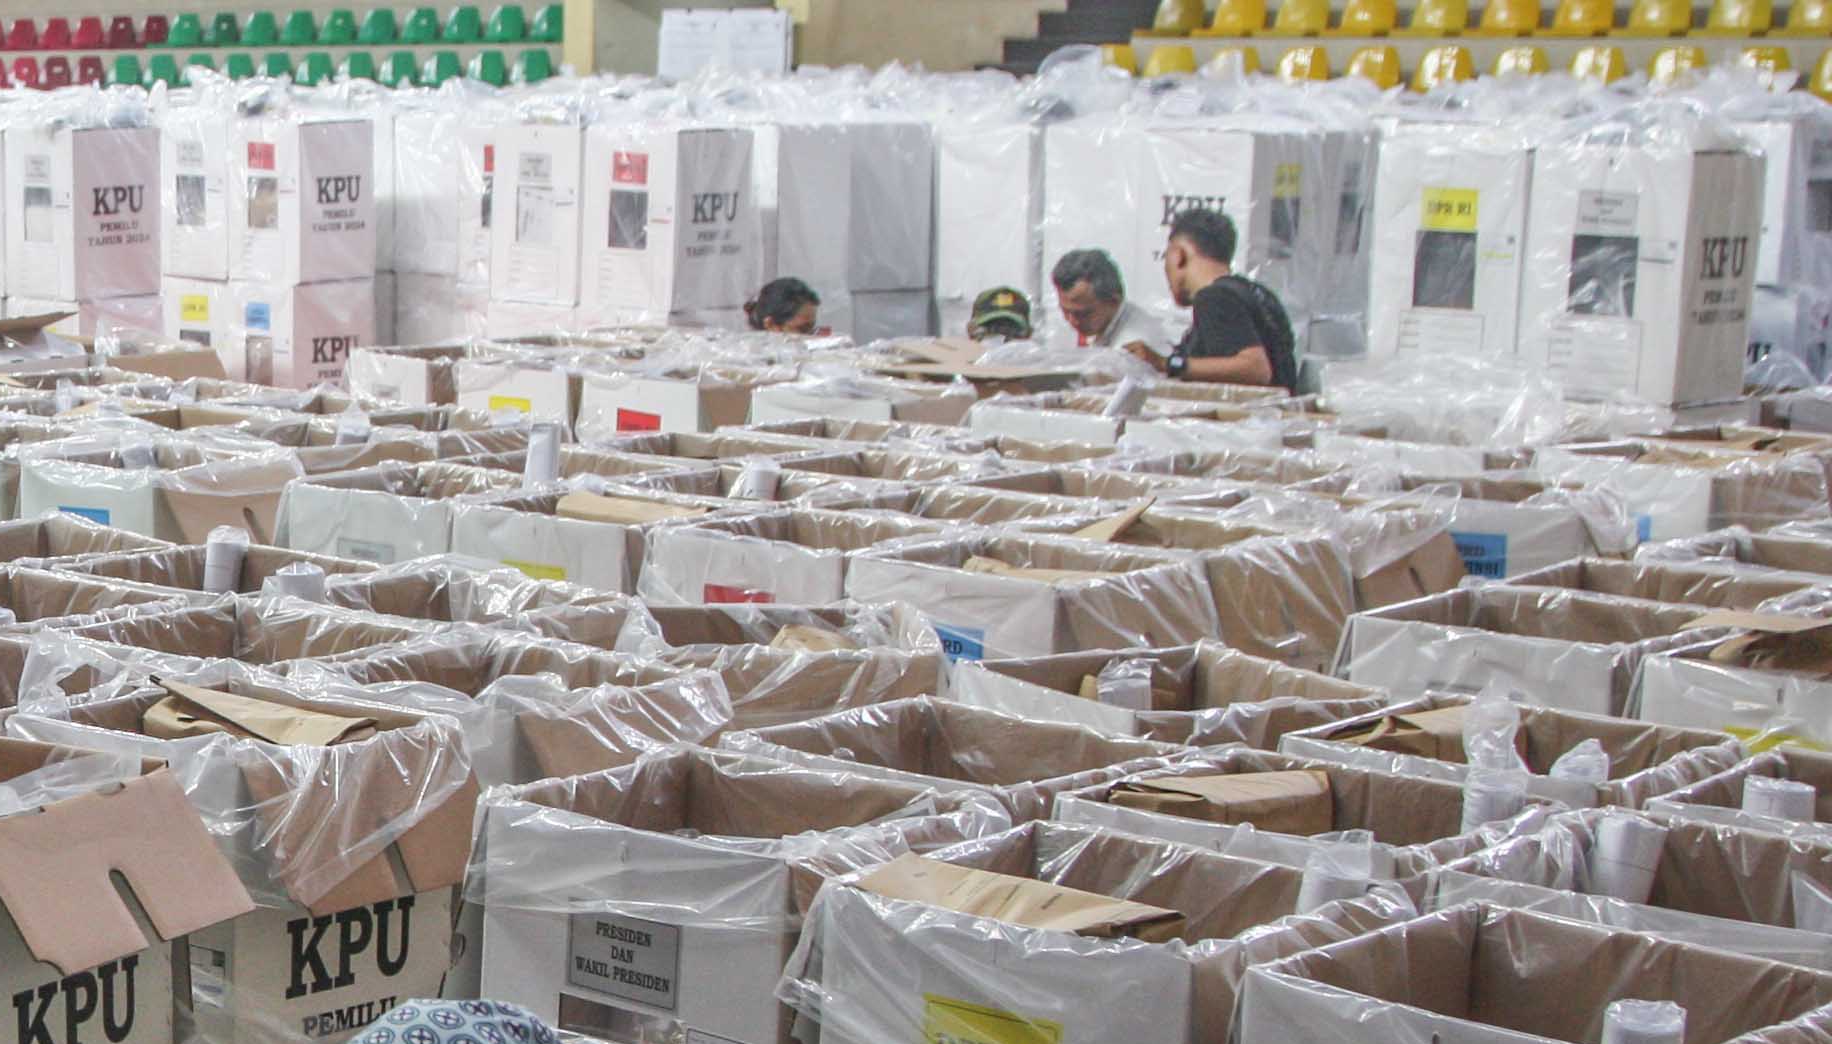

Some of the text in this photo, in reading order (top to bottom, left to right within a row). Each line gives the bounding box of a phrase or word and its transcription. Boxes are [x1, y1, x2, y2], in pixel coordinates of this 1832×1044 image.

[92, 184, 145, 217] KPU
[316, 175, 361, 206] KPU
[691, 192, 739, 225] KPU
[943, 639, 963, 656] RD
[285, 895, 416, 1000] KPU
[595, 920, 652, 947] PRESIDEN
[610, 945, 635, 964] DAN
[574, 955, 671, 993] WAKIL PRESIDEN
